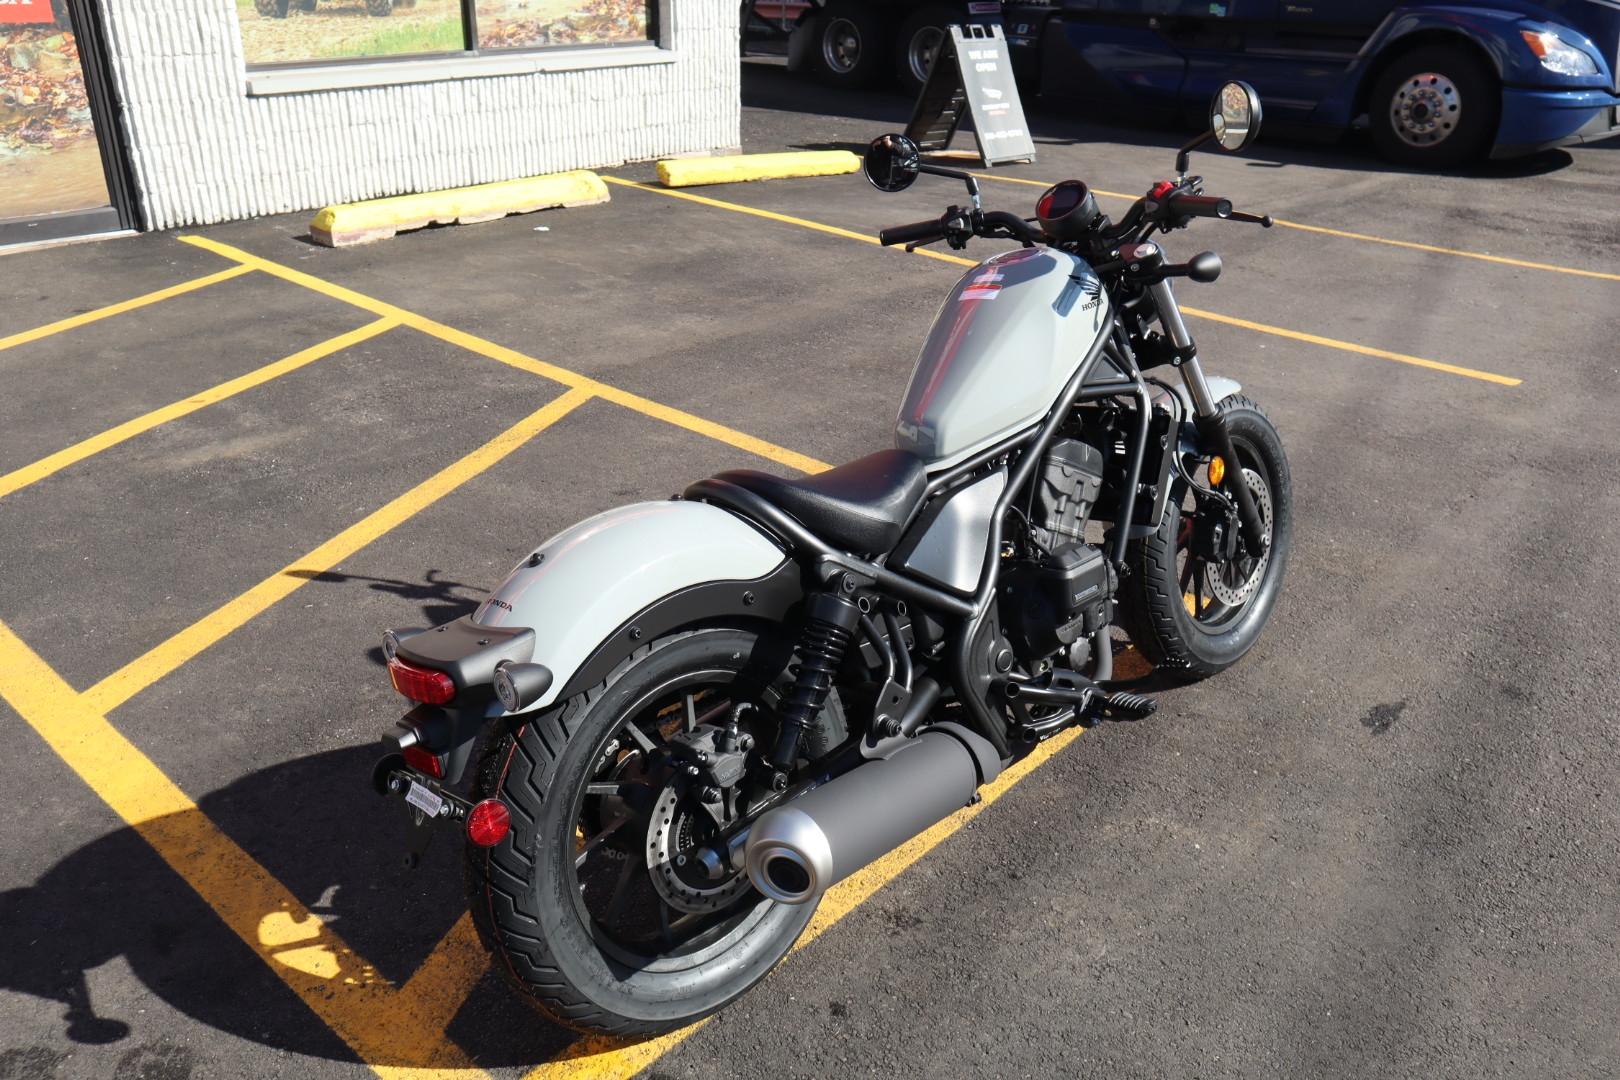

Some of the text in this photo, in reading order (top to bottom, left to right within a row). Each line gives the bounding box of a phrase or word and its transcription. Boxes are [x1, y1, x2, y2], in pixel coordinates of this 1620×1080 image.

[968, 49, 999, 60] WE ARE
[975, 62, 997, 72] OPEN
[1082, 299, 1104, 311] HONDA
